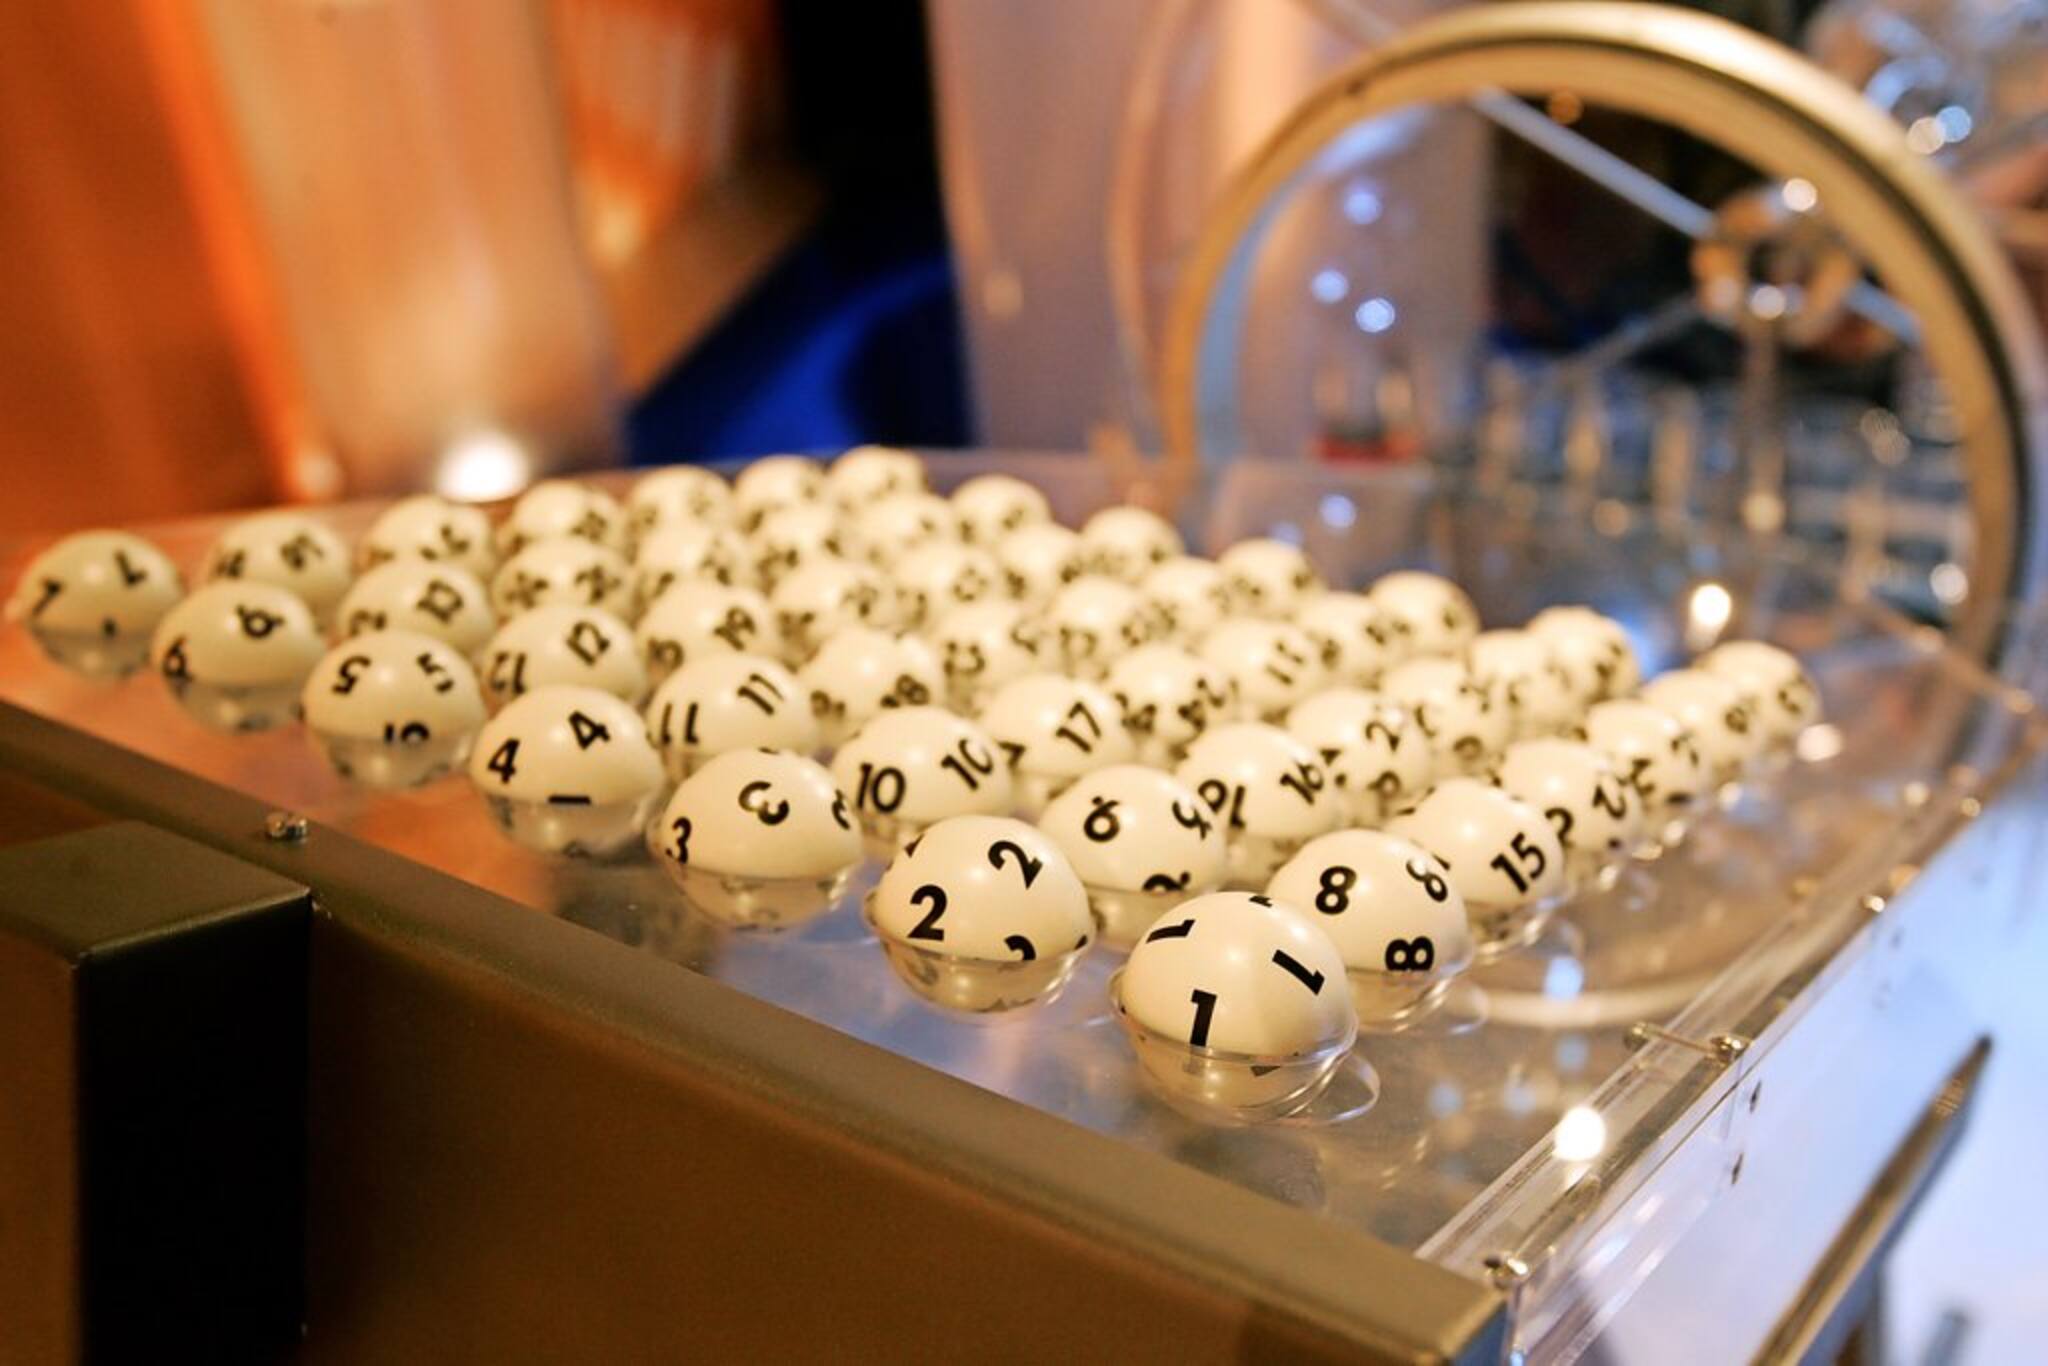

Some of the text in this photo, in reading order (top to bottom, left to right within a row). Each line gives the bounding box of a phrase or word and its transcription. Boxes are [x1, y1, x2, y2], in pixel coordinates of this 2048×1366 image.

[333, 657, 370, 694] 5
[738, 674, 784, 715] 11
[569, 712, 610, 749] 4
[1056, 702, 1100, 753] 17
[488, 739, 519, 783] 4
[941, 740, 993, 790] 10
[739, 782, 789, 825] 3
[856, 764, 905, 814] 10
[665, 818, 691, 866] 3
[988, 841, 1042, 888] 2
[1491, 833, 1545, 894] 15
[908, 885, 947, 941] 2
[1316, 866, 1356, 915] 8
[1273, 950, 1324, 995] 1
[1385, 937, 1434, 972] 8
[1190, 990, 1216, 1050] 1
